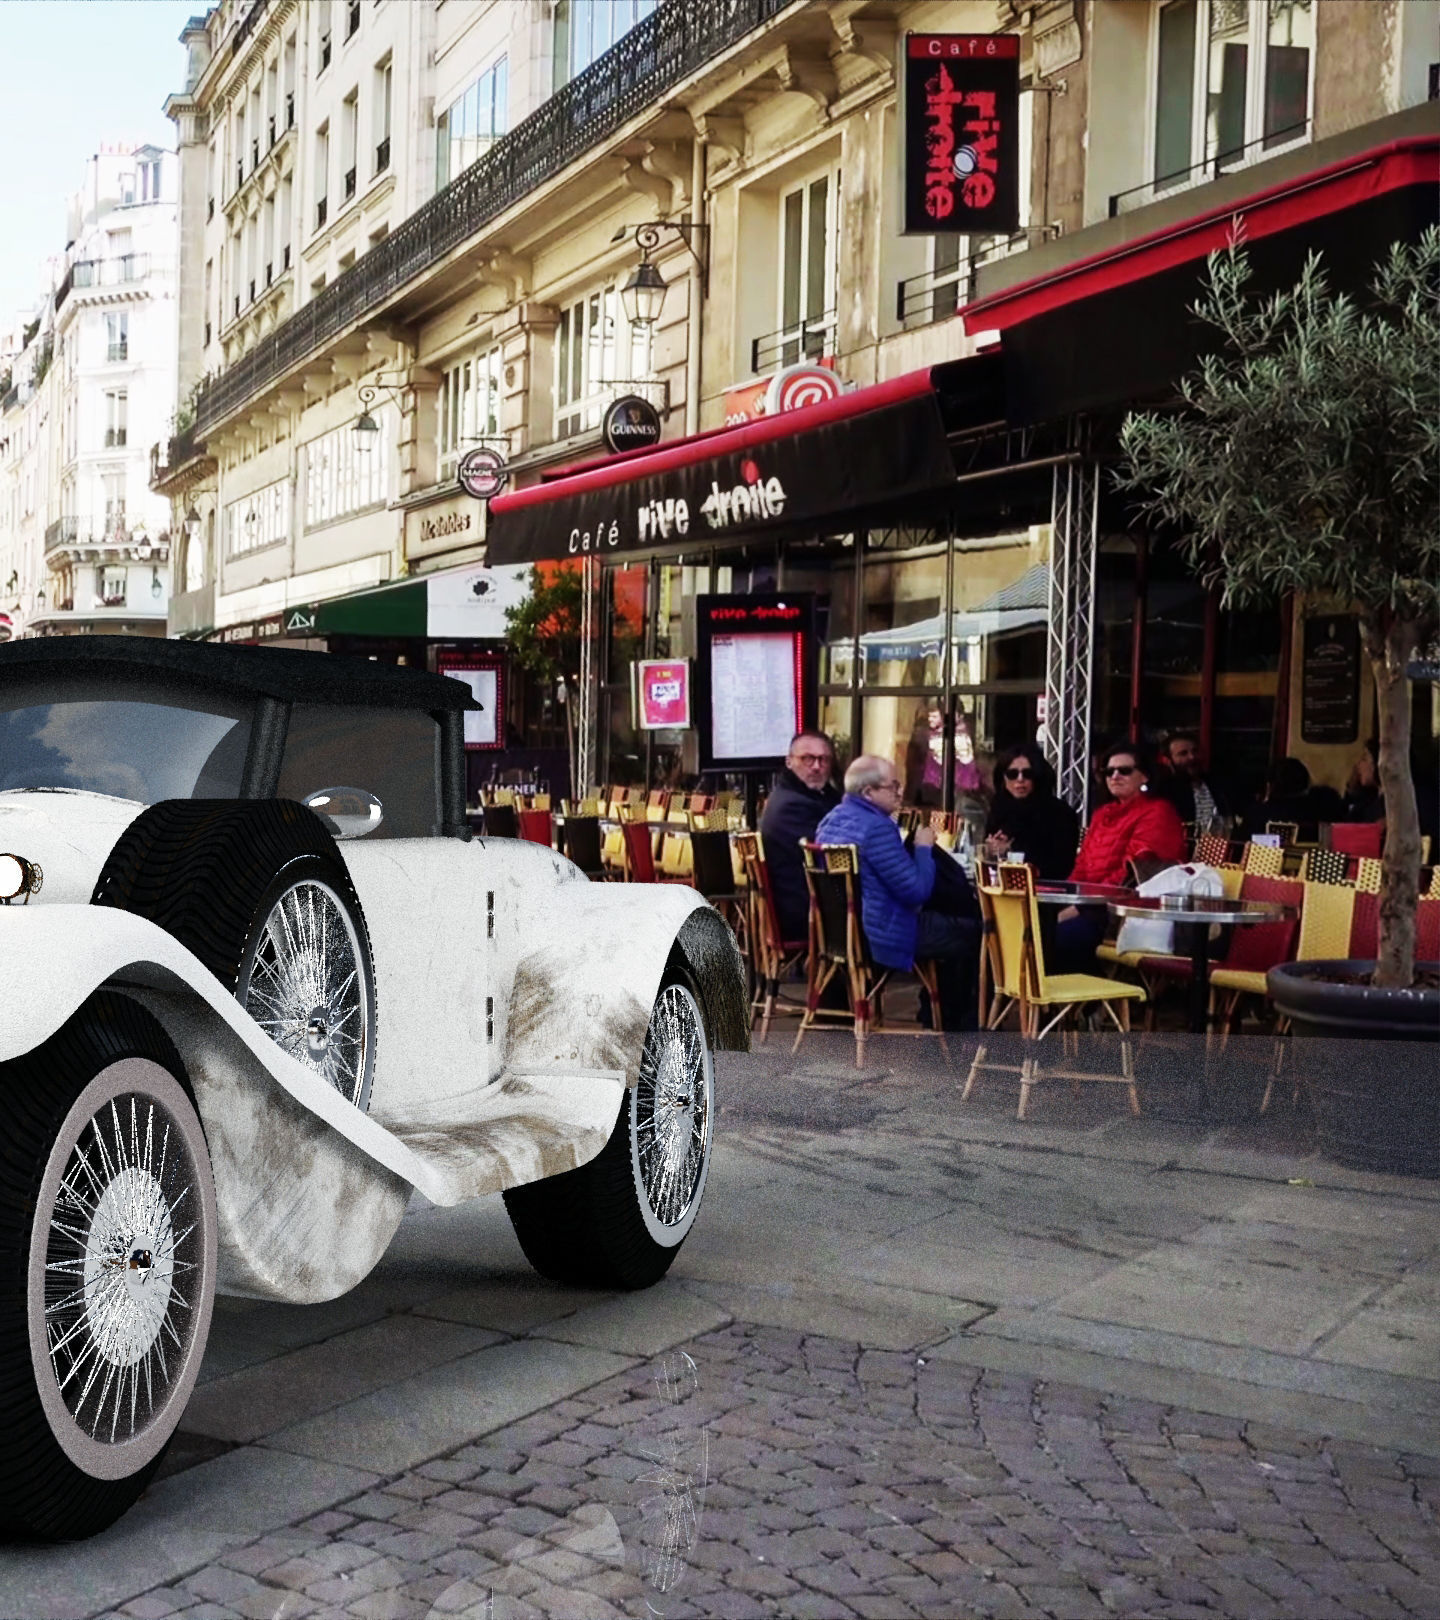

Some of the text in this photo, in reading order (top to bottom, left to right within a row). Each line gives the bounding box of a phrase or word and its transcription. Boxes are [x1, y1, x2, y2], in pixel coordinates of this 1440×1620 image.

[928, 40, 996, 55] Café
[962, 92, 1001, 209] rive
[611, 423, 656, 436] GUINNESS
[463, 468, 494, 478] MAGNE
[569, 460, 788, 553] Café rive droite
